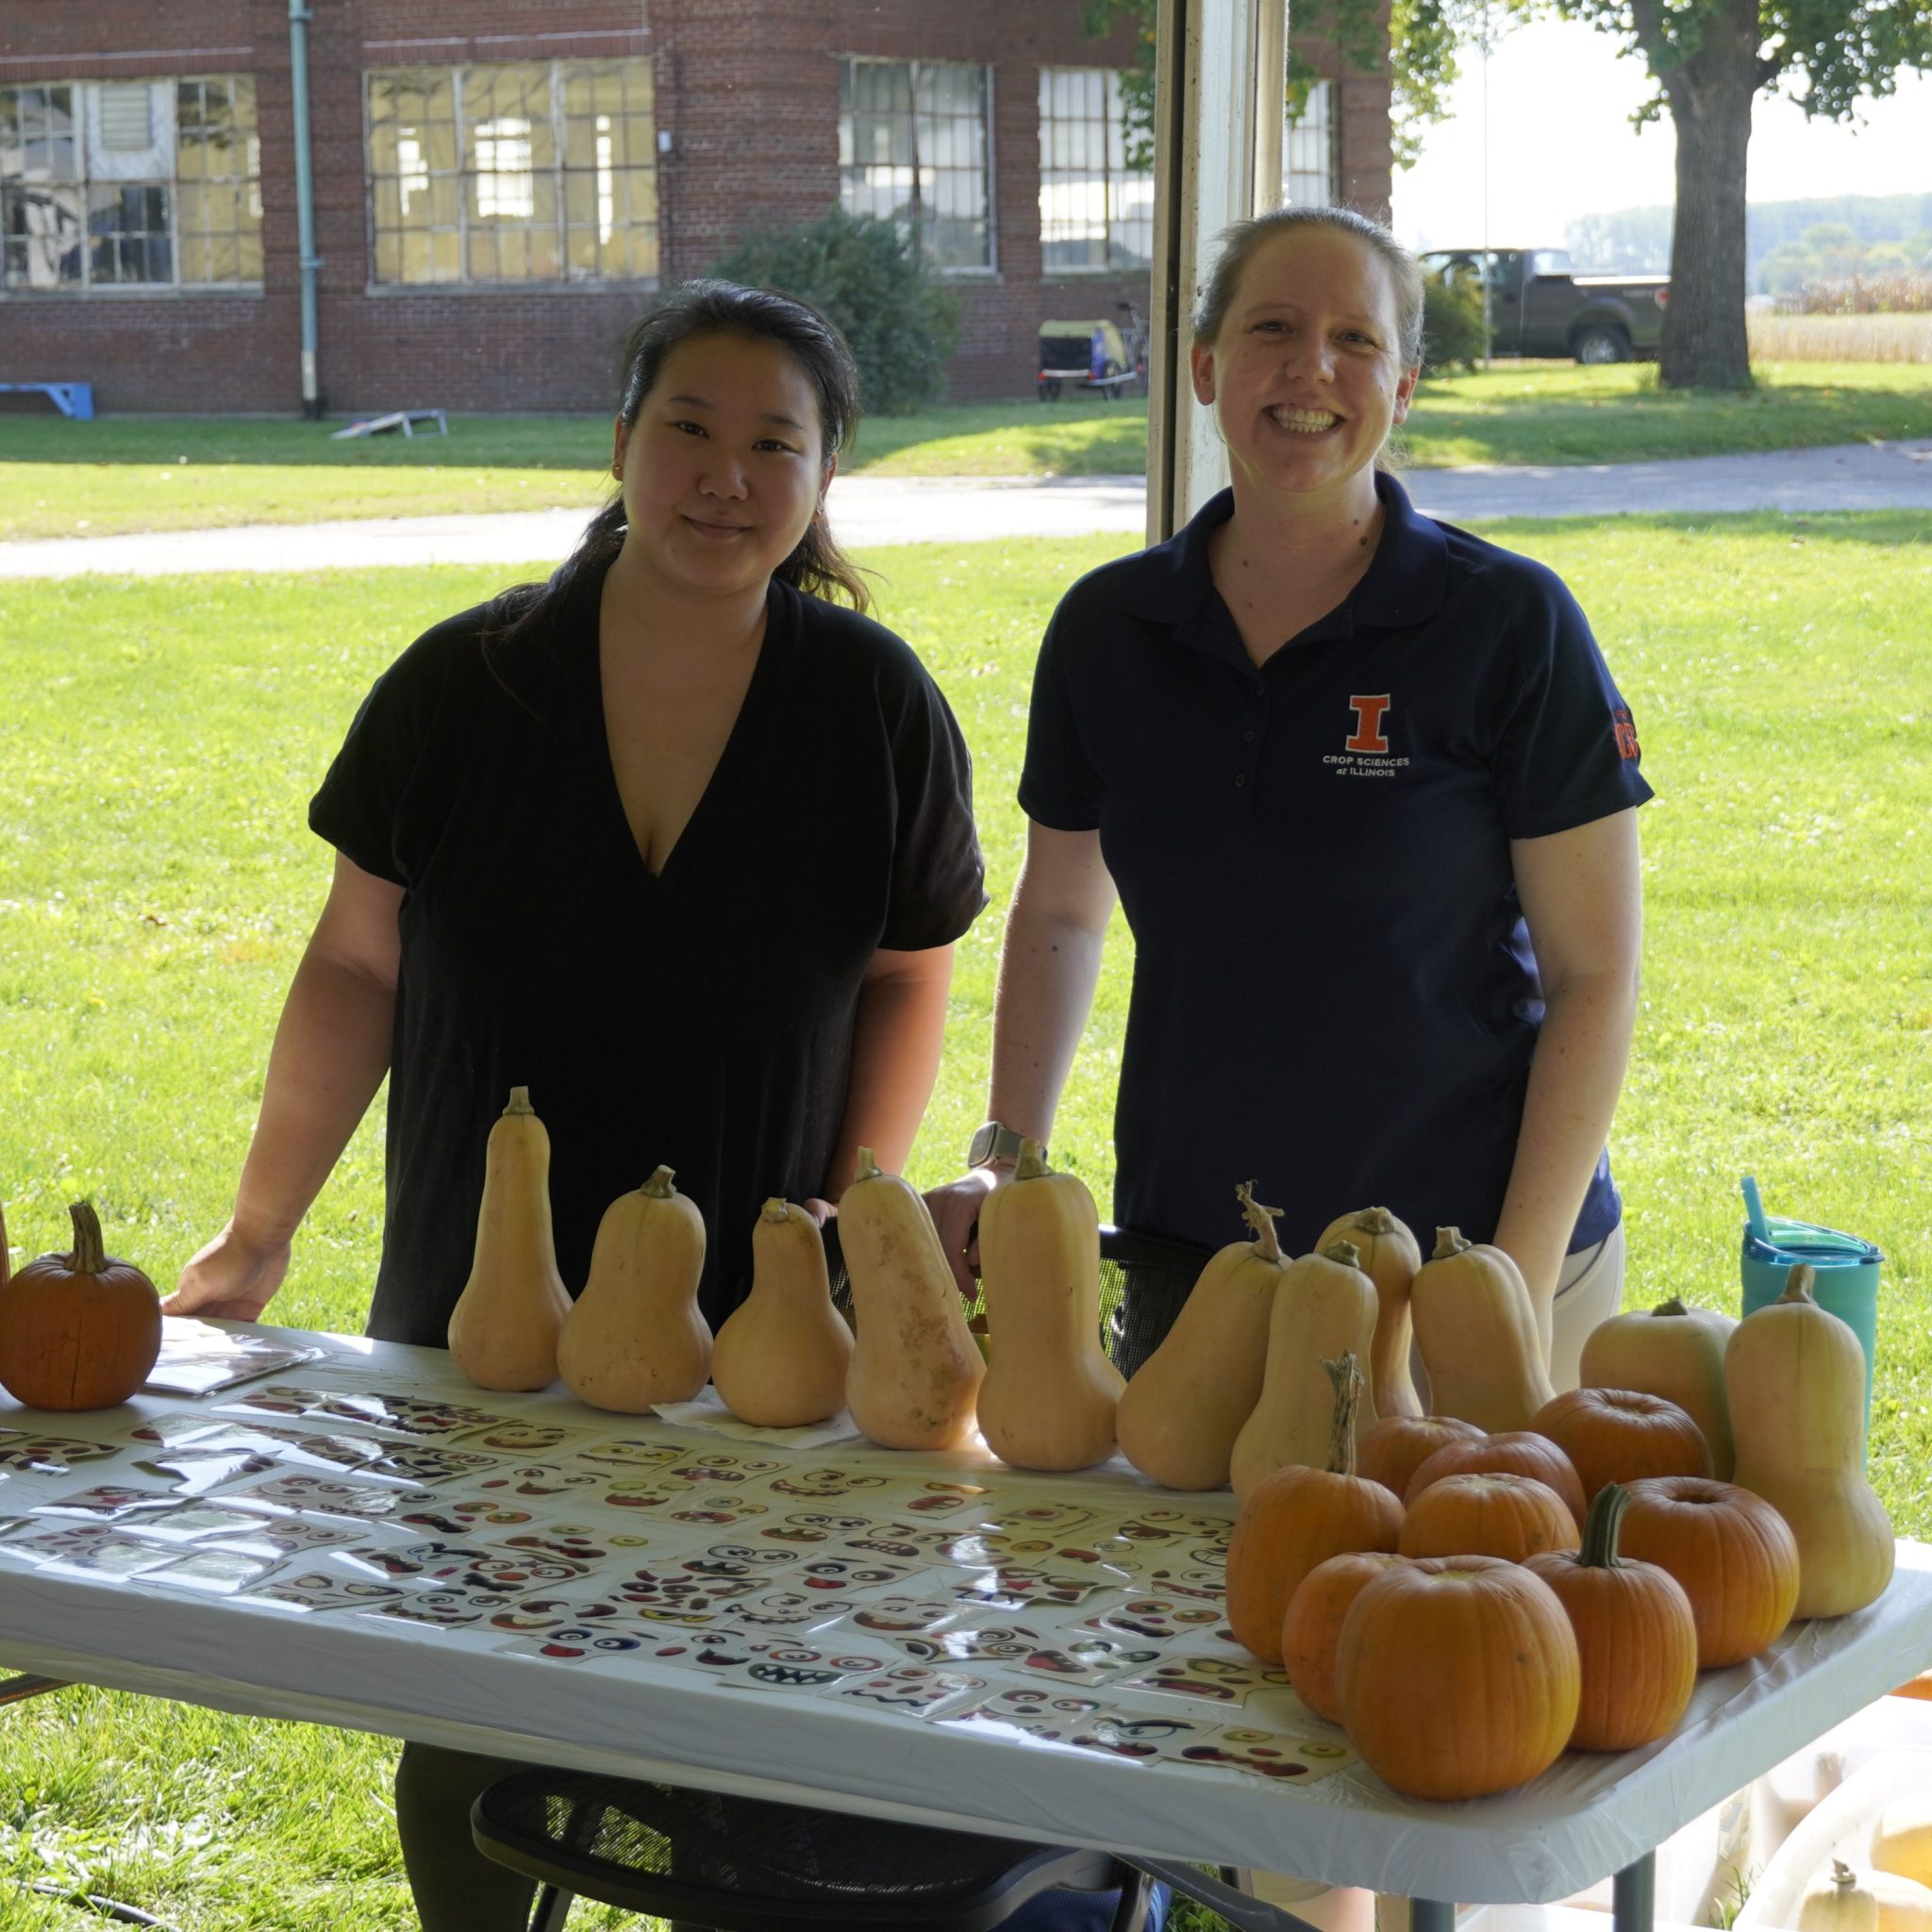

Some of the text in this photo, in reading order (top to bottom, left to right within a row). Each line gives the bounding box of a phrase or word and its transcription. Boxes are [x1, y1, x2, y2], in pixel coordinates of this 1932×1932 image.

[1345, 693, 1391, 753] I
[1323, 756, 1409, 766] CROP SCIENCES
[1350, 767, 1395, 776] ILLINOIS
